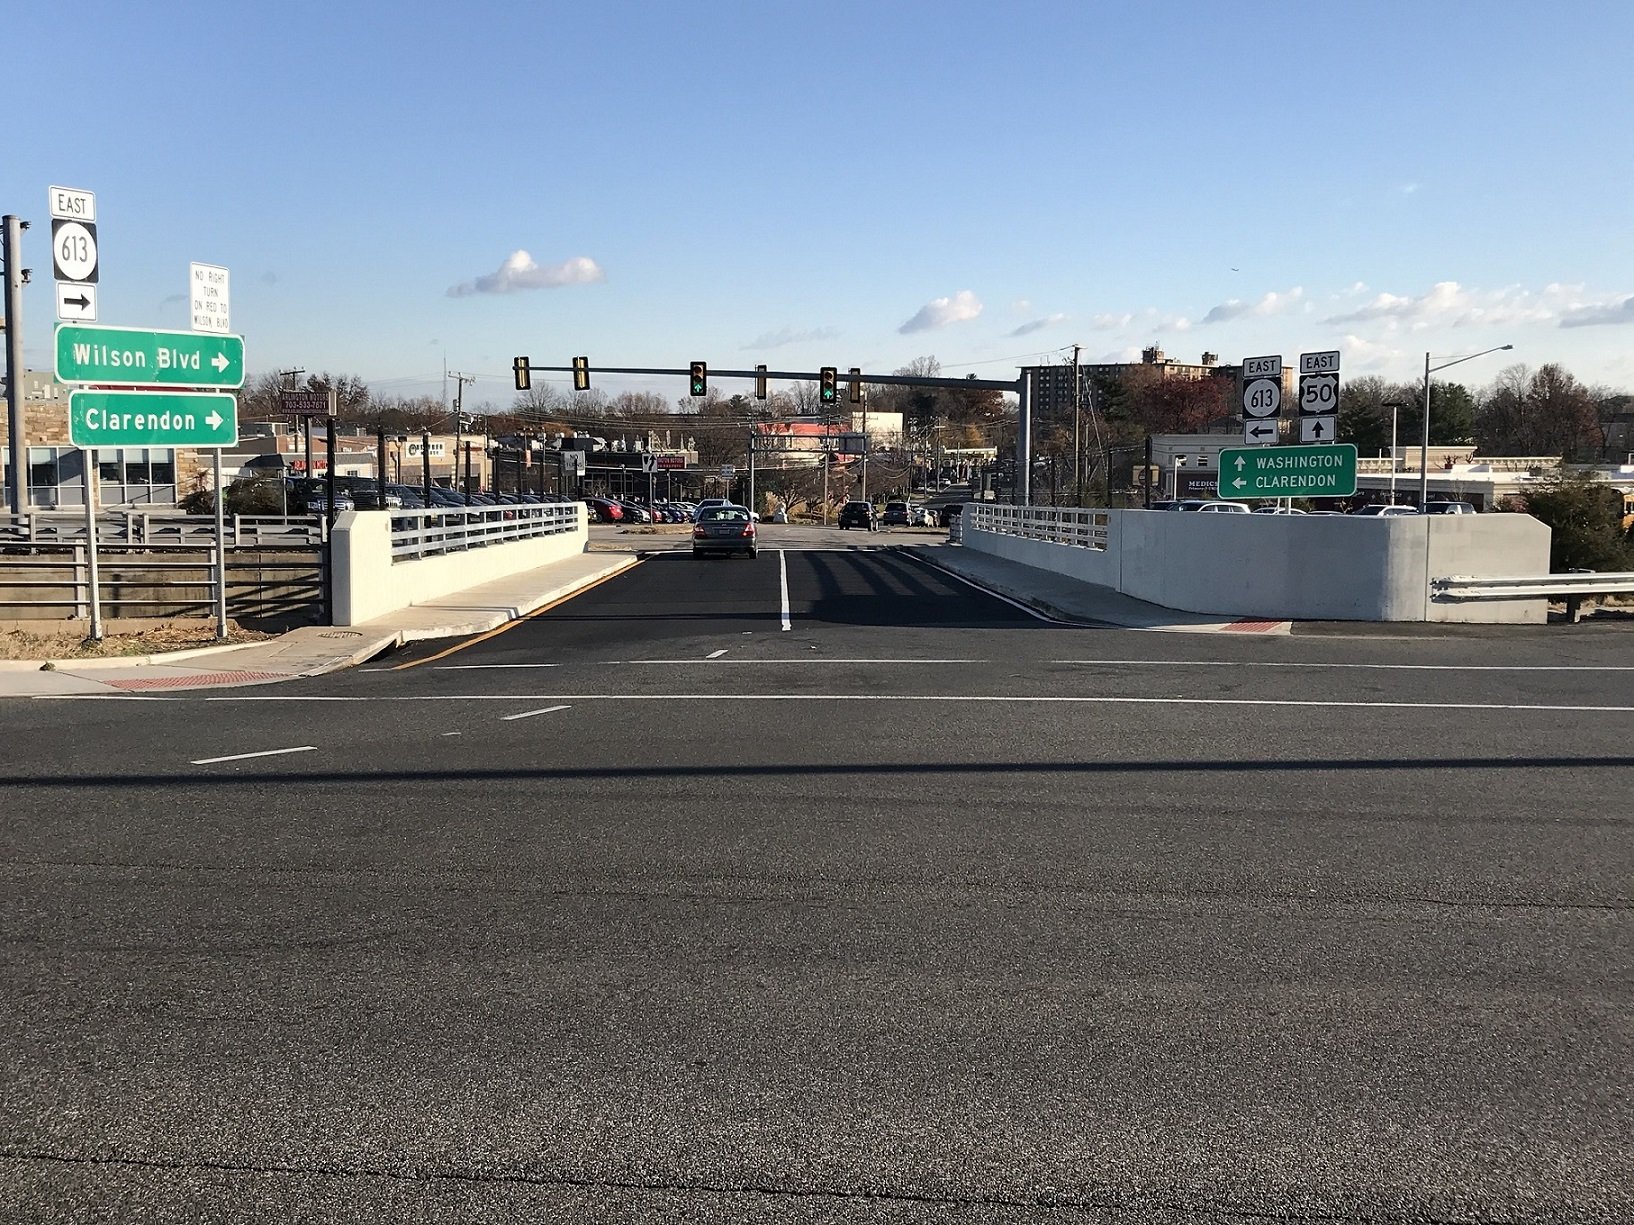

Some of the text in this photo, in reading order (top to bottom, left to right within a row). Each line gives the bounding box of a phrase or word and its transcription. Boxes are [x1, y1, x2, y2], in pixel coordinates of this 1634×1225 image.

[58, 193, 86, 214] EAST
[62, 235, 88, 262] 613
[195, 270, 225, 284] NO RIGHT
[203, 285, 219, 298] TURN
[194, 299, 228, 314] ON RED TO
[193, 314, 229, 329] WILSON BLVD
[73, 342, 201, 370] Wilson Blvd
[1306, 355, 1335, 369] EAST
[1248, 359, 1277, 374] EAST
[1251, 388, 1274, 408] 613
[1306, 383, 1333, 404] 50
[85, 408, 196, 431] Clarendon
[1256, 454, 1343, 469] WASHINGTON
[1256, 474, 1337, 488] CLARENDON
